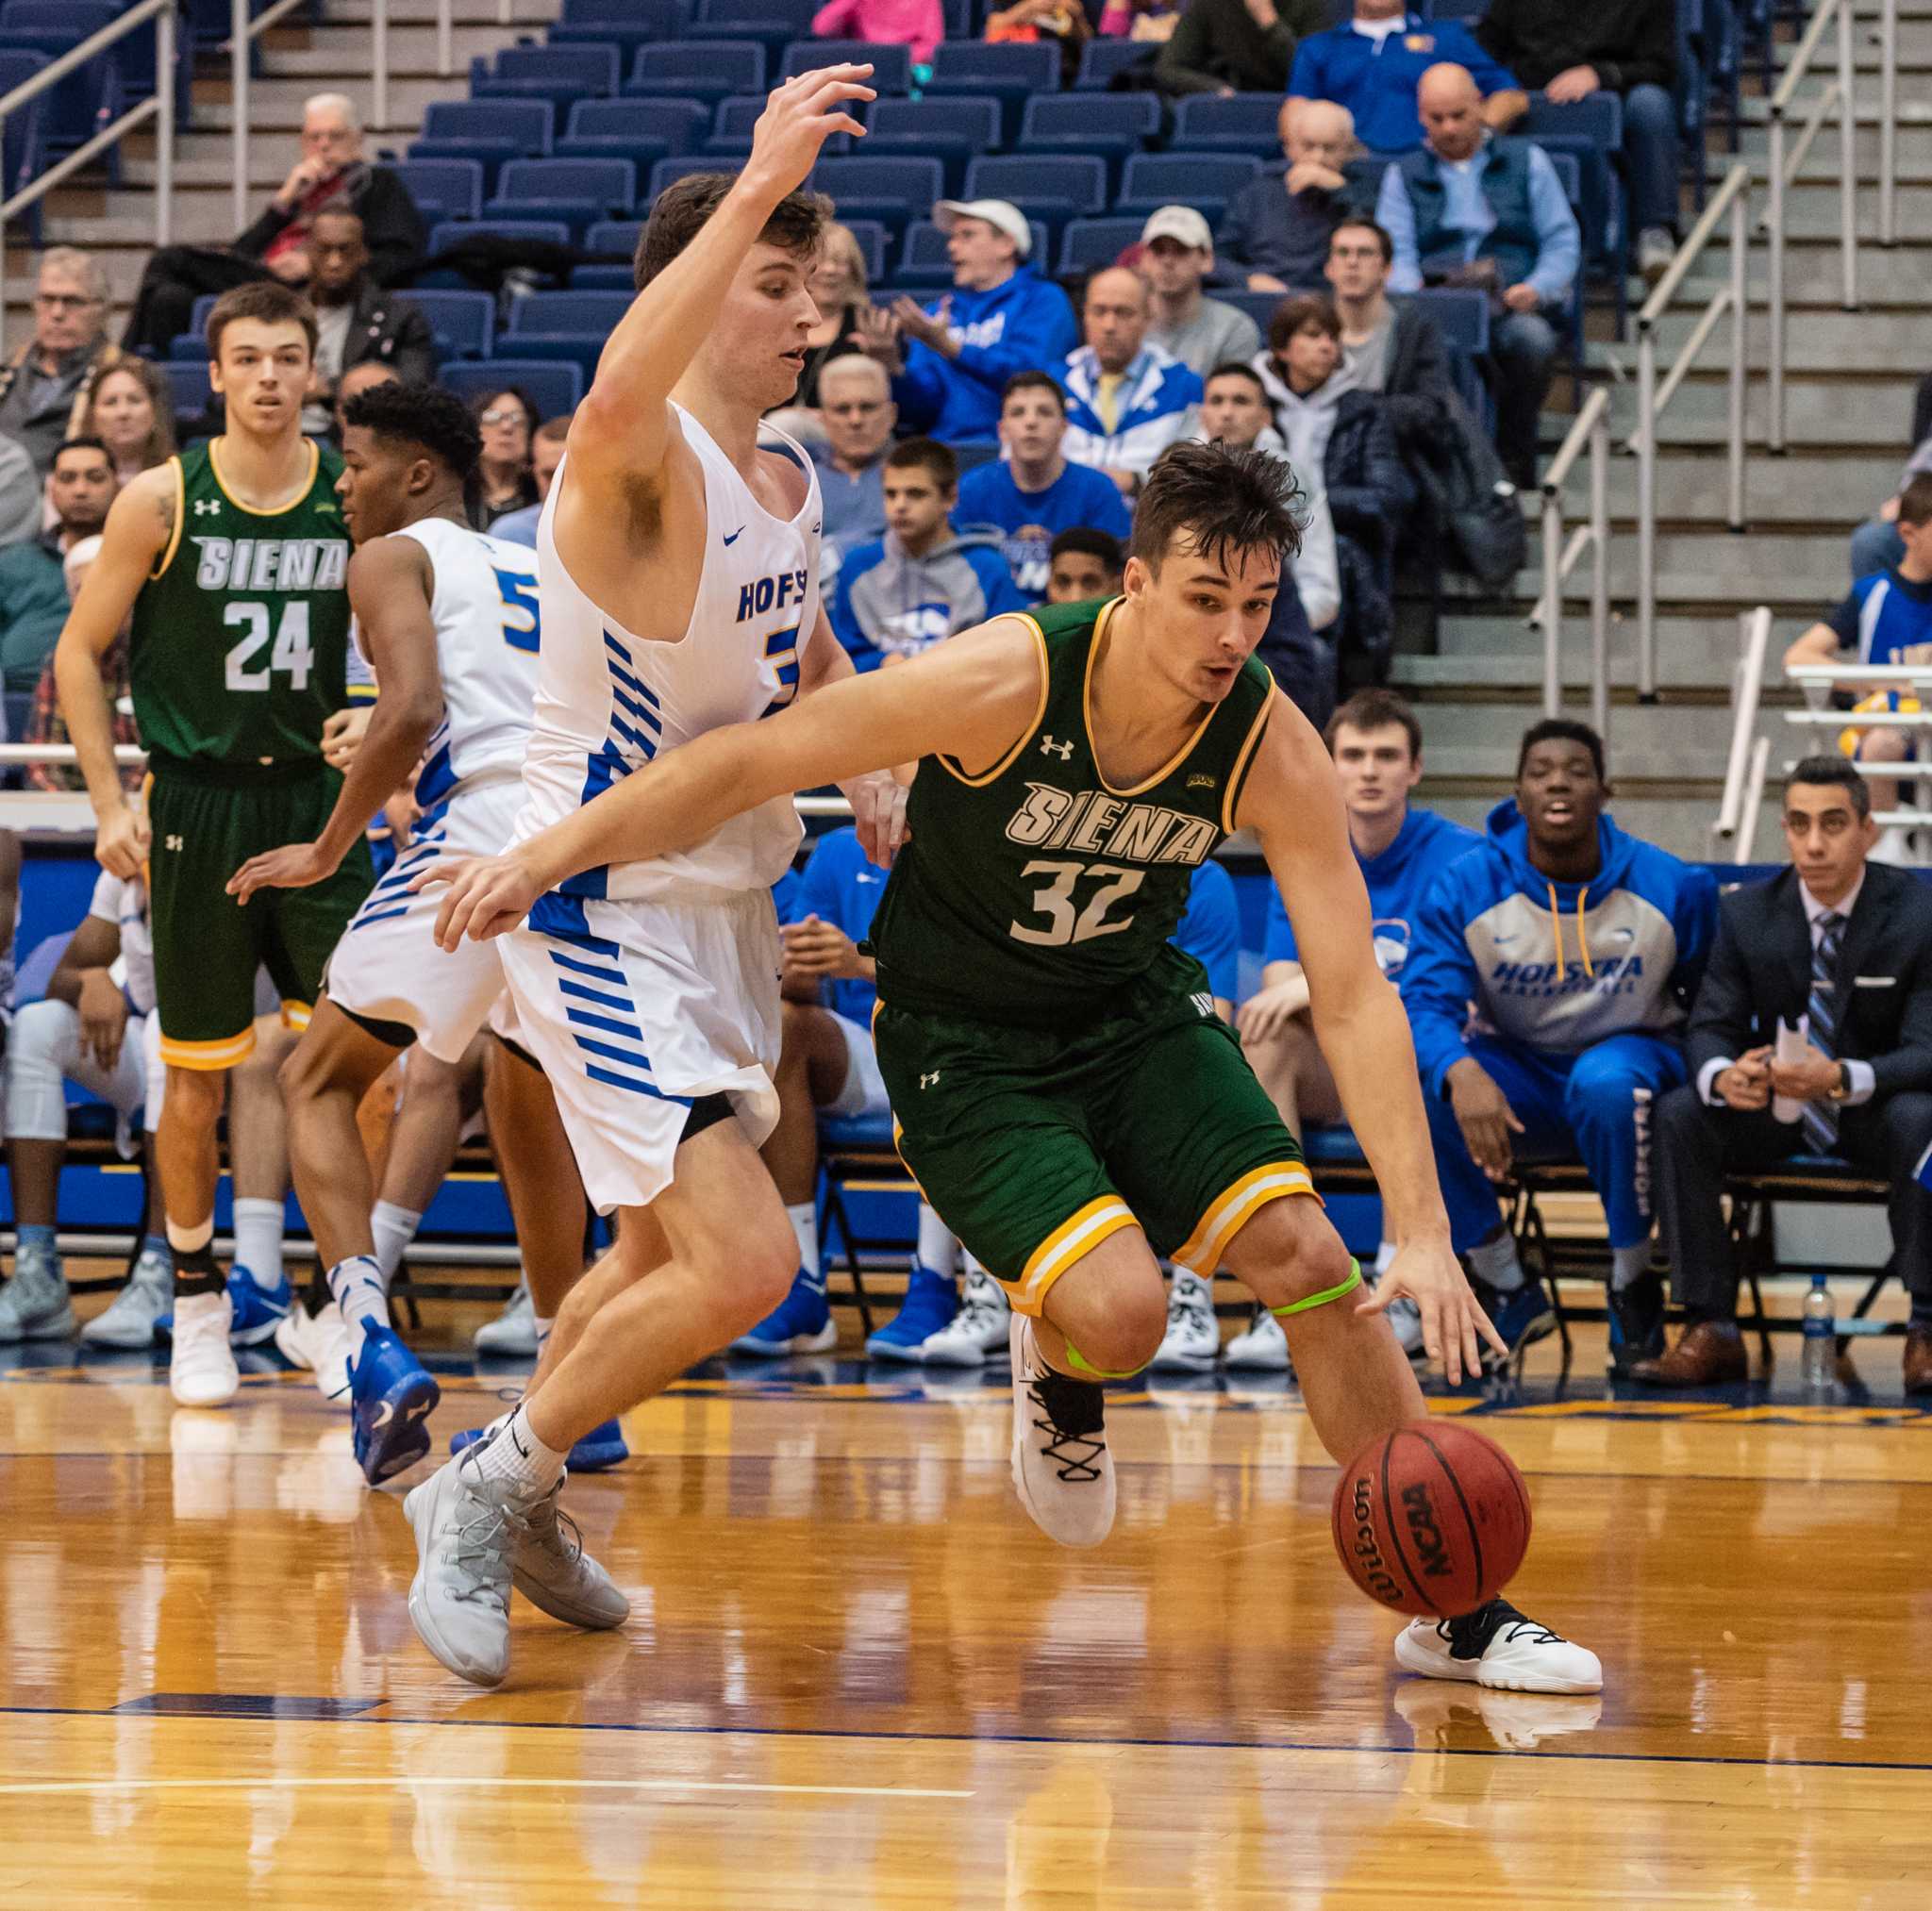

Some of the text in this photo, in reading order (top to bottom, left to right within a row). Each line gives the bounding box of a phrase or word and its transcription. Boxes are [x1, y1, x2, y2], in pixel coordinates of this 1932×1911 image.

[190, 536, 348, 590] SIENA
[224, 601, 314, 691] 24
[490, 564, 541, 656] 5
[1005, 782, 1219, 865] SIENA
[1009, 860, 1146, 946] 32
[1353, 1471, 1404, 1603] Wilson
[1401, 1480, 1453, 1577] NCAA
